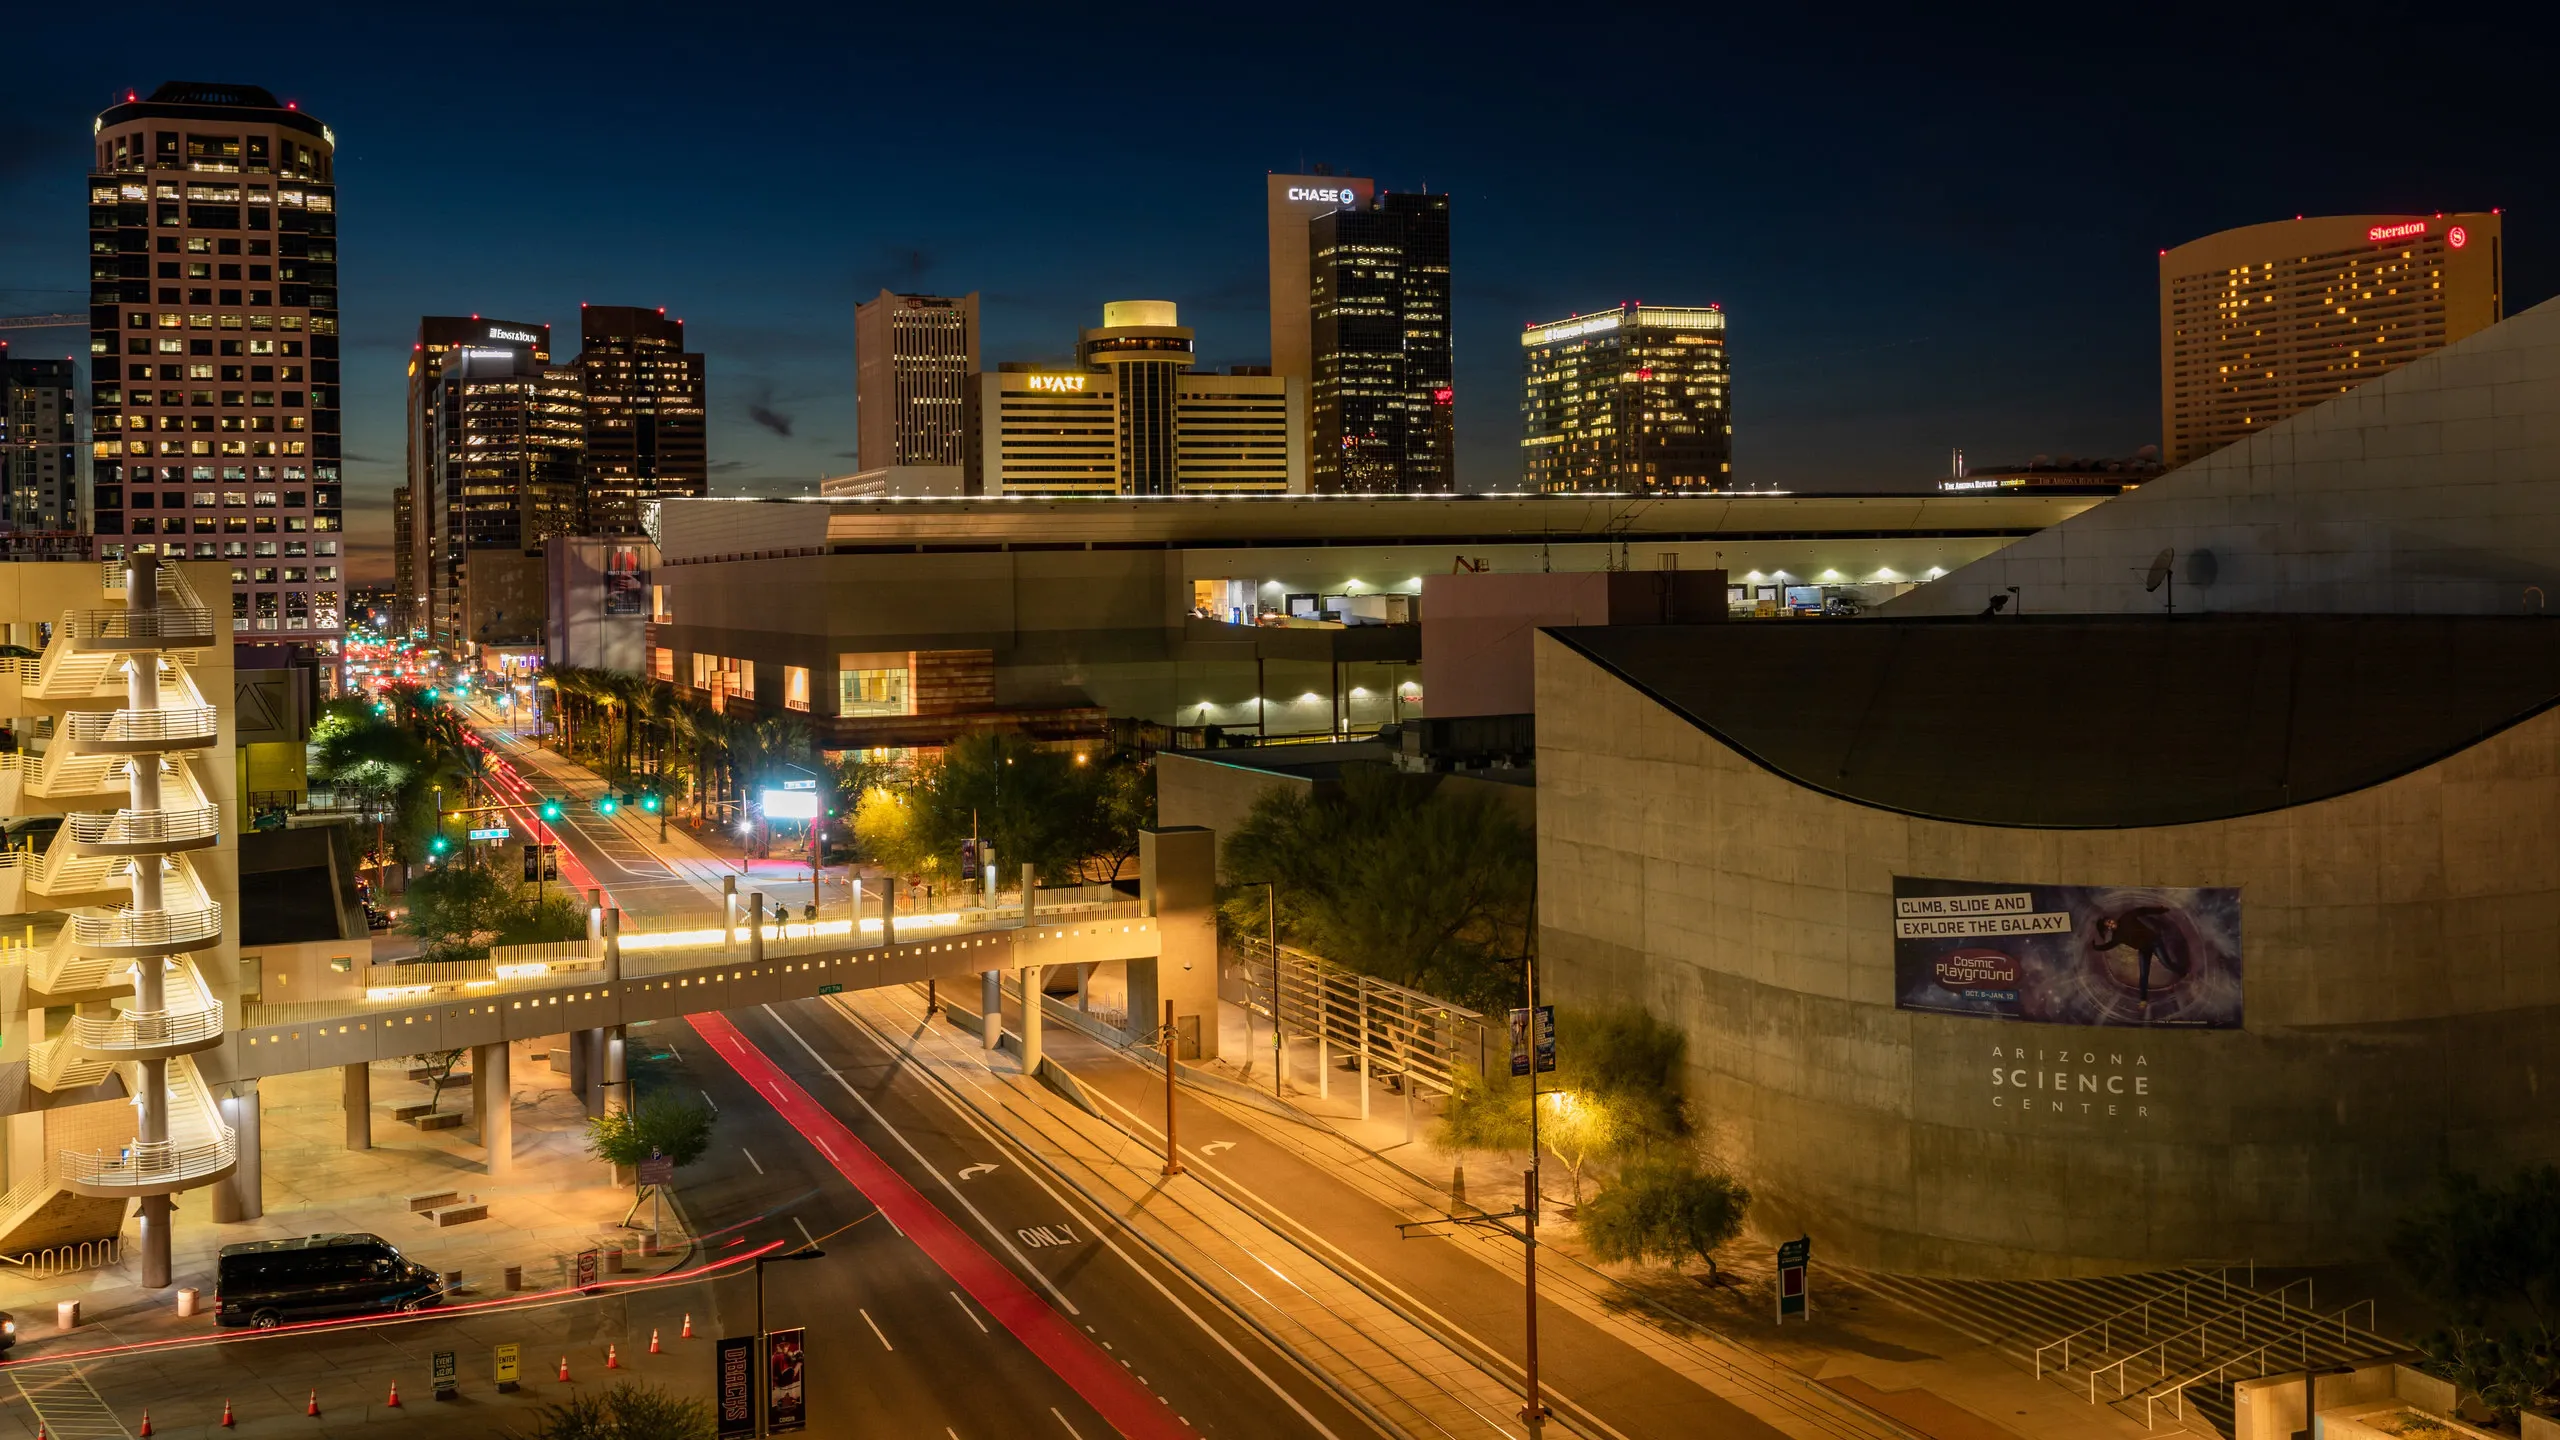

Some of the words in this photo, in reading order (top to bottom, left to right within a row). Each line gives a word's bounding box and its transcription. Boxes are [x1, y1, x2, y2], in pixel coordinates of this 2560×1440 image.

[1288, 188, 1339, 202] CHASE
[2369, 222, 2426, 241] Sheraton
[1030, 376, 1085, 392] HYATT
[1902, 901, 1947, 917] CLIMB,
[1950, 899, 1990, 913] SLIDE
[1994, 897, 2026, 911] AND
[1903, 921, 1965, 936] EXPLORE
[1968, 919, 1998, 934] THE
[2001, 916, 2063, 933] GALAXY
[1936, 963, 2014, 981] Playground
[1953, 956, 1994, 969] Cosmic
[1992, 1046, 2148, 1066] ARIZONA
[1992, 1067, 2149, 1096] SCIENCE
[1992, 1096, 2148, 1117] CENTER
[1017, 1223, 1082, 1248] ONLY
[499, 1355, 516, 1364] ENTER
